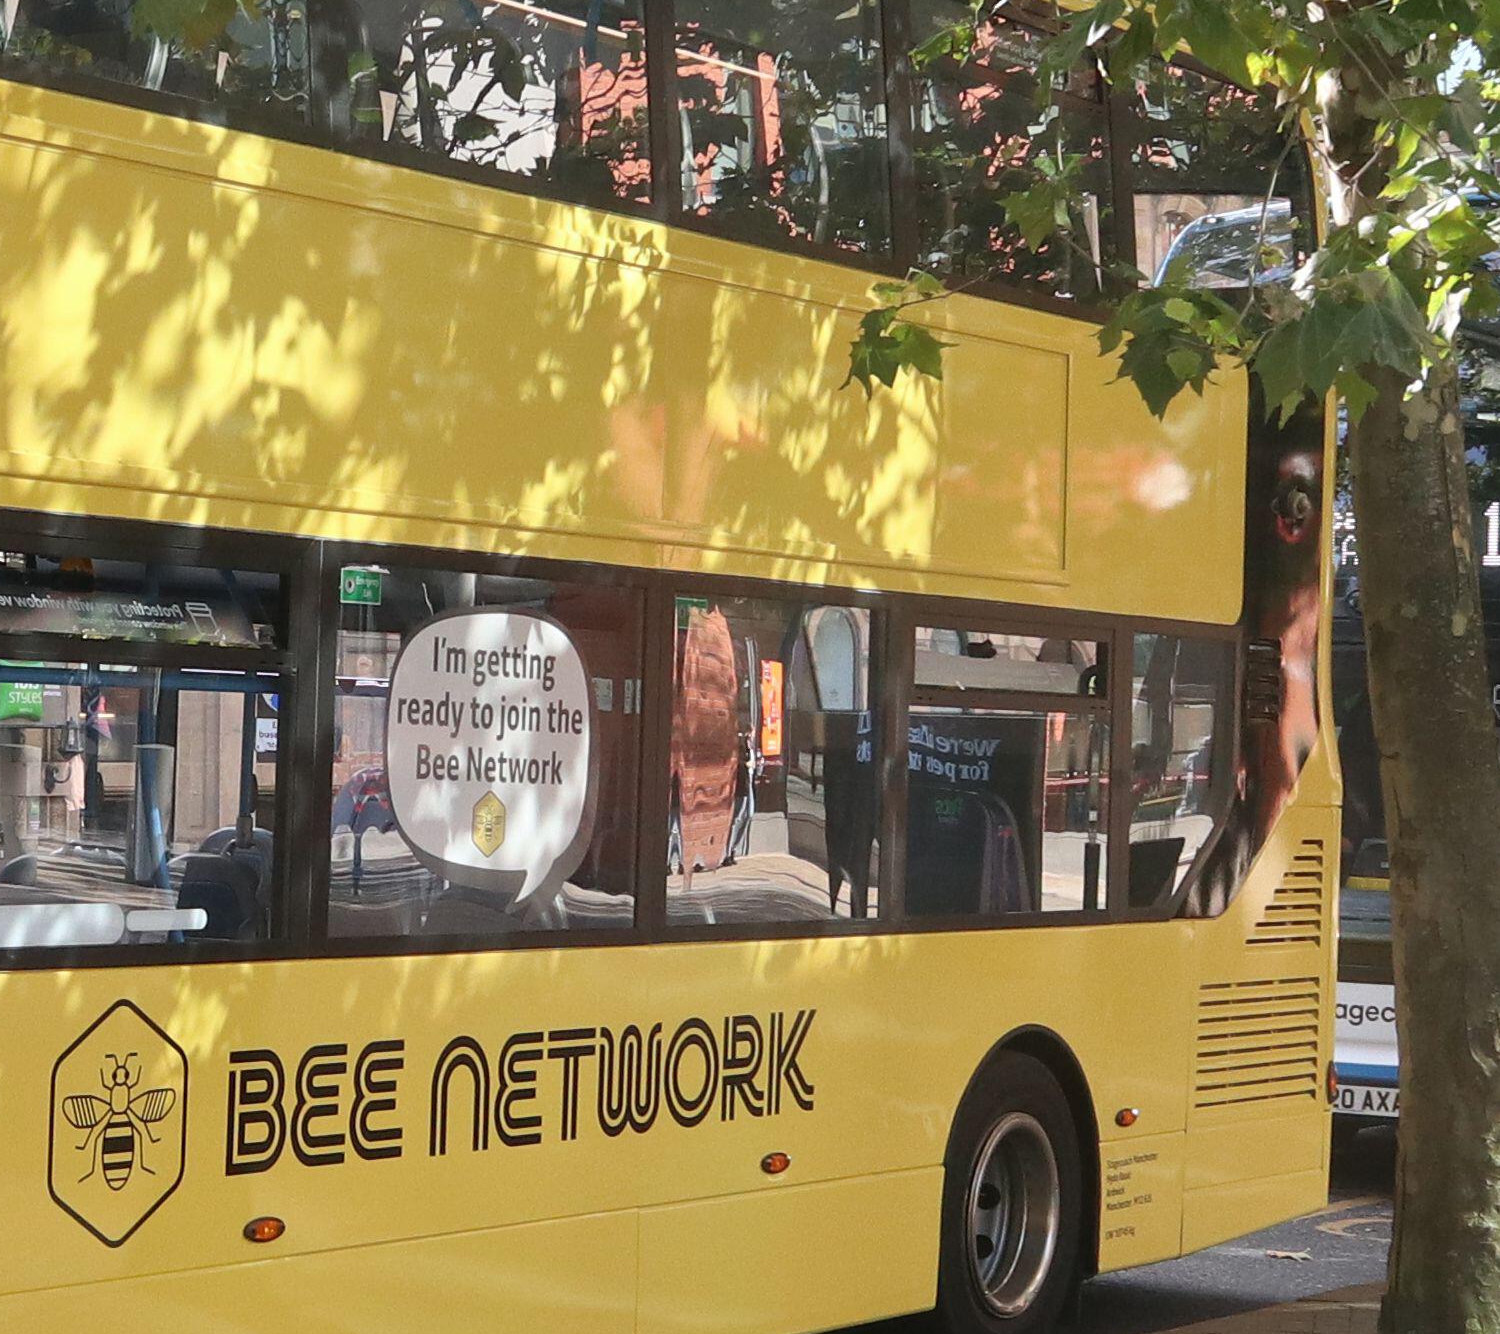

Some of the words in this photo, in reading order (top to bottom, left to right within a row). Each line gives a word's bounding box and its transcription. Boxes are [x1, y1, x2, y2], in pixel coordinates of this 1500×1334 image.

[432, 635, 467, 675] I'm
[473, 644, 557, 692] getting
[396, 694, 464, 740] ready
[470, 698, 494, 730] to
[495, 696, 543, 741] join
[547, 701, 584, 735] the
[415, 743, 459, 782] Bee
[466, 745, 564, 786] Network
[224, 1038, 406, 1177] BEE
[428, 1008, 817, 1158] NETWORK
